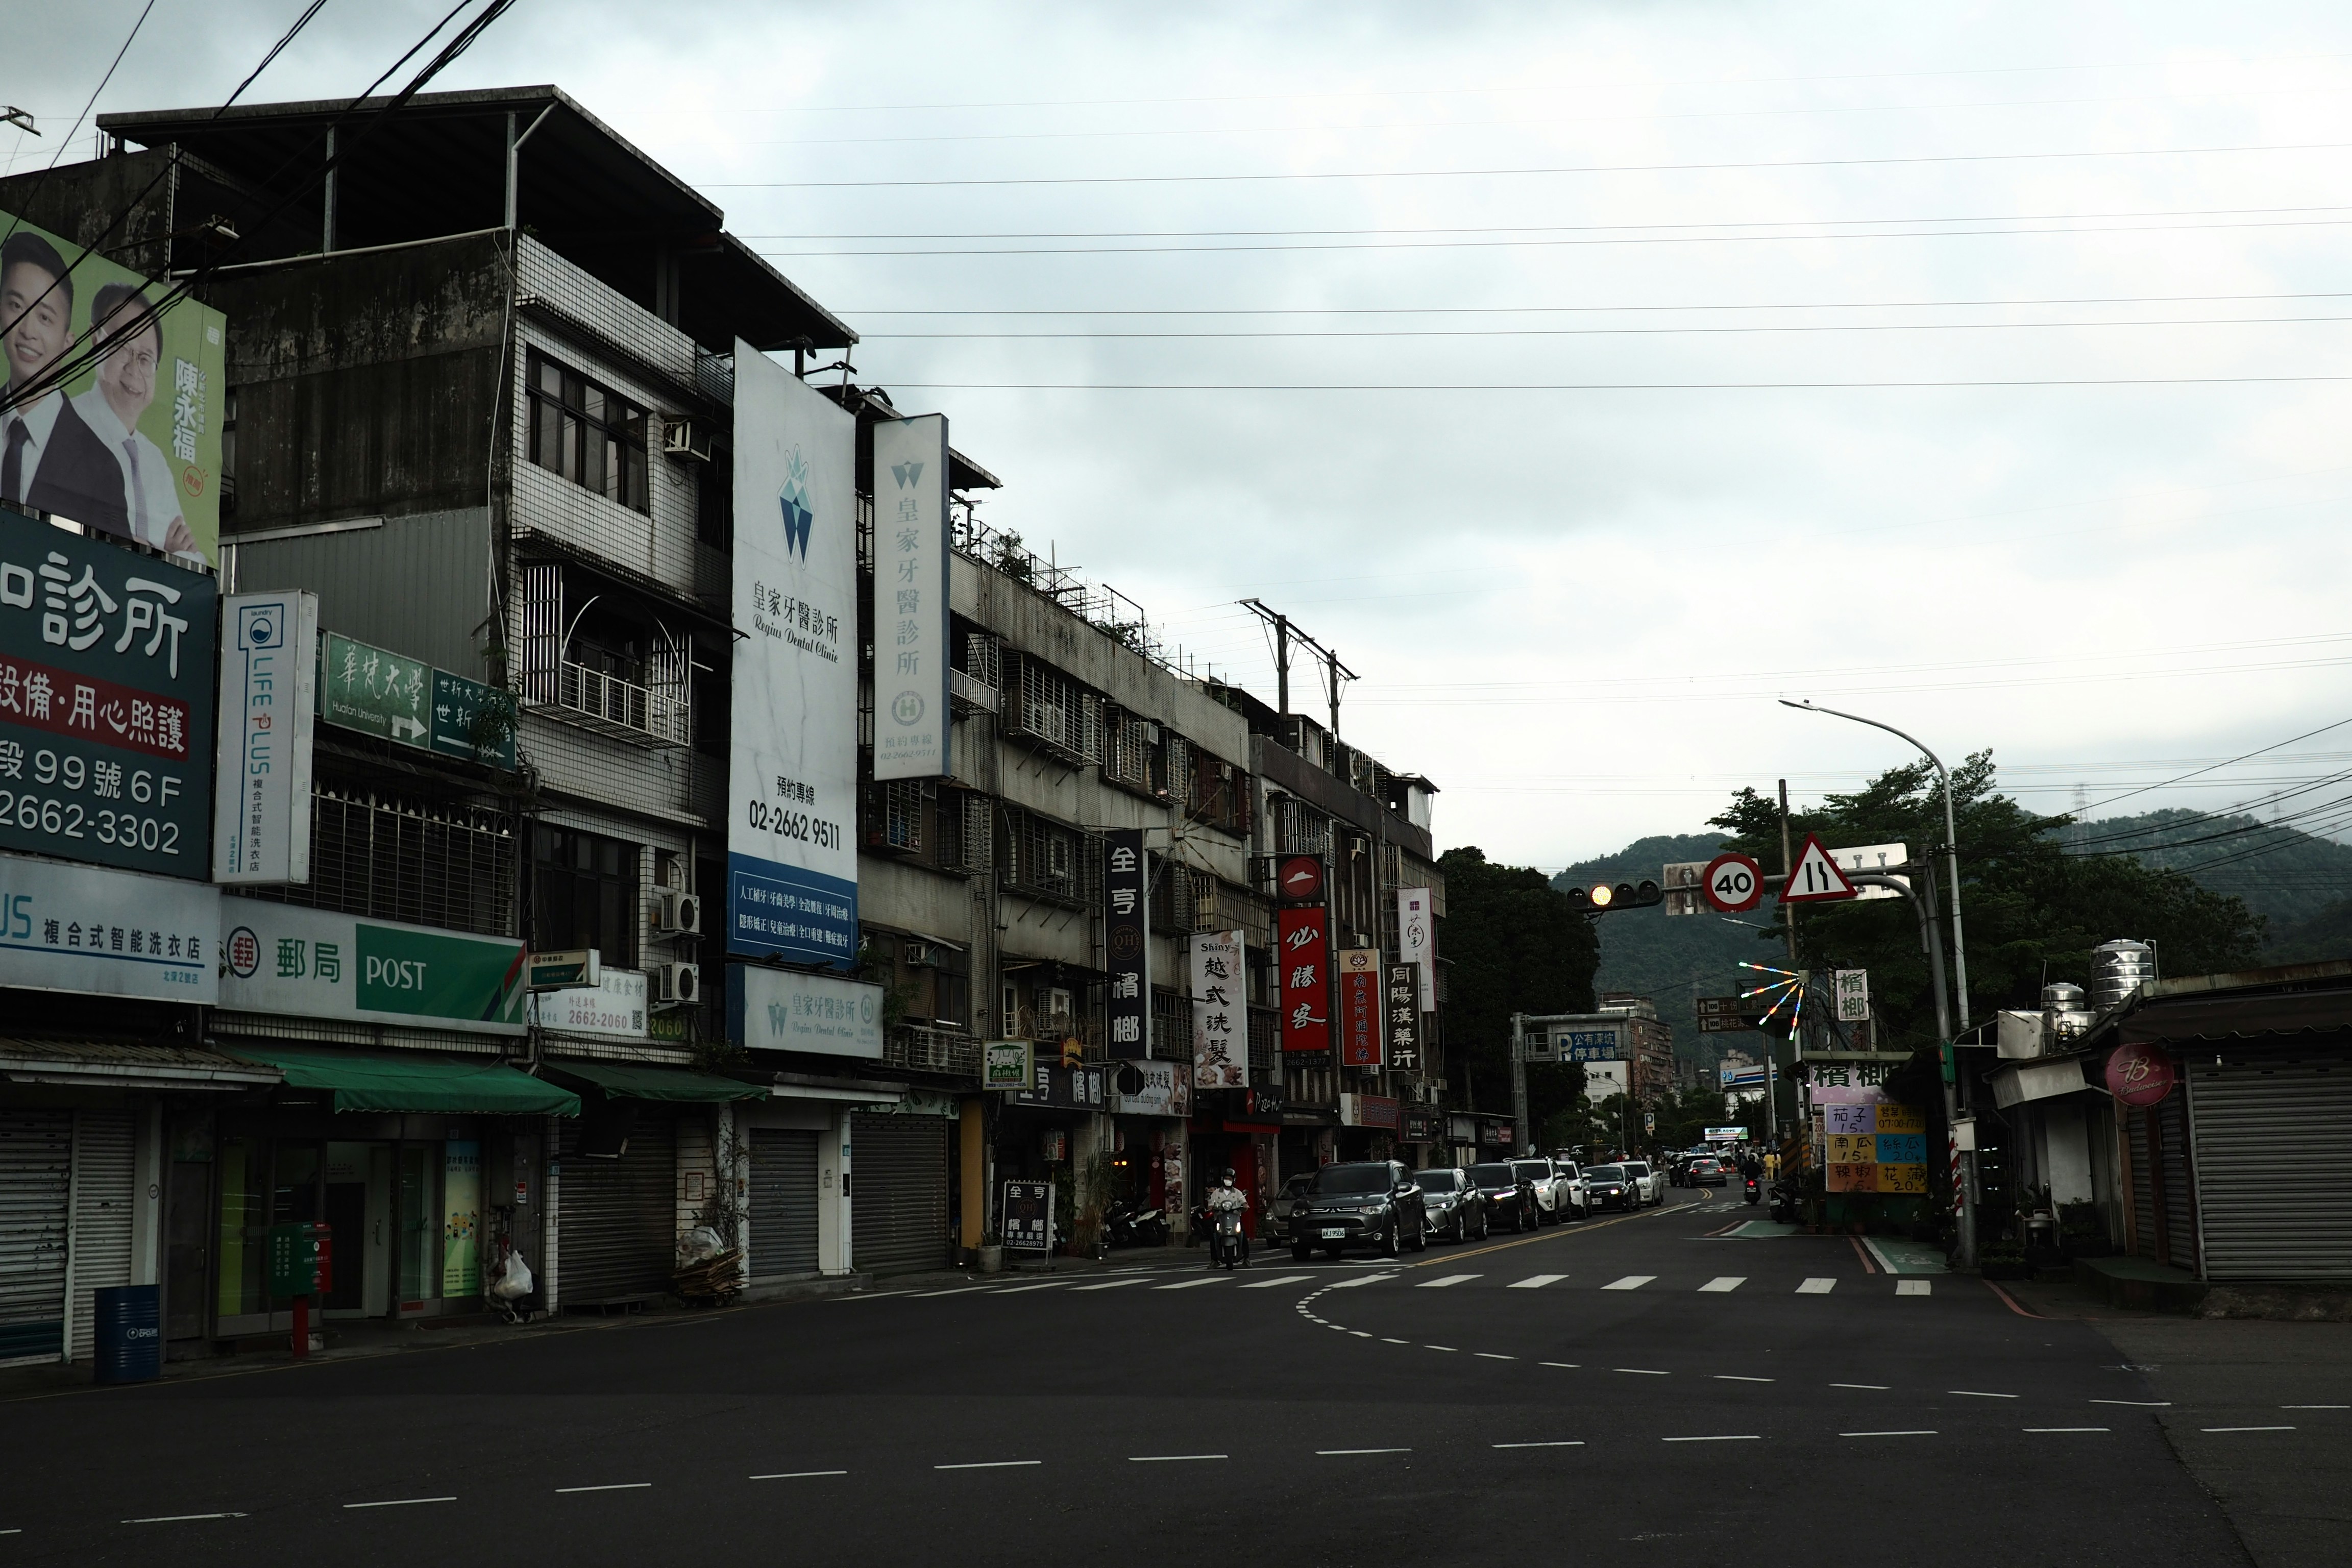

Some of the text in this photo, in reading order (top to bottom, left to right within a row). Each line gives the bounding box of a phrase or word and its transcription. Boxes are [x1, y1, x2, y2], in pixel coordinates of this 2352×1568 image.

[173, 358, 199, 464] 陳永福
[896, 497, 920, 677] 皇家牙醫診所
[753, 580, 838, 644] 皇家牙醫診所
[753, 614, 839, 664] Regius Dental Clinic
[337, 645, 424, 712] 華梵大學
[250, 657, 273, 774] LIFE PLUS
[333, 700, 387, 727] Huafan University
[880, 749, 936, 761] 02-2662-9511
[886, 733, 932, 749] 預約專線
[777, 775, 815, 806] 預約專線
[249, 778, 263, 872] 複合式智能洗衣店
[749, 800, 840, 851] 02-2662 9511
[1715, 873, 1752, 895] 40
[44, 918, 200, 960] 複合式智能洗衣店
[1111, 846, 1139, 1043] 全亨 檳榔
[1114, 935, 1134, 950] QH
[1200, 942, 1231, 952] Shiny
[277, 938, 340, 983] 郵局
[366, 955, 427, 991] POST
[163, 970, 199, 985] 北深2號店
[1286, 925, 1326, 1030] 必勝客
[793, 993, 855, 1022] 皇家牙醫診所
[1841, 973, 1865, 1017] 檳榔
[569, 1010, 627, 1029] 2662-2060
[1204, 957, 1233, 1064] 越式洗髮
[1353, 973, 1369, 1063] 南無阿彌陀佛
[1390, 966, 1417, 1069] 同陽漢藥行
[814, 1023, 835, 1037] Dental
[1575, 1033, 1614, 1046] 公有深坑
[1286, 1058, 1327, 1066] 2662-1377
[1557, 1034, 1573, 1062] P
[1574, 1046, 1615, 1061] 停車場
[1072, 1069, 1101, 1105] 檳榔
[1814, 1062, 1892, 1088] 檳榔
[2118, 1080, 2168, 1096] Budweiser
[1255, 1091, 1283, 1113] Pizza Hut
[1833, 1108, 1866, 1122] 茄子
[1646, 1114, 1653, 1126] P
[1834, 1136, 1872, 1149] 南瓜
[1882, 1136, 1920, 1150] 絲瓜
[1835, 1165, 1871, 1179] 辣椒
